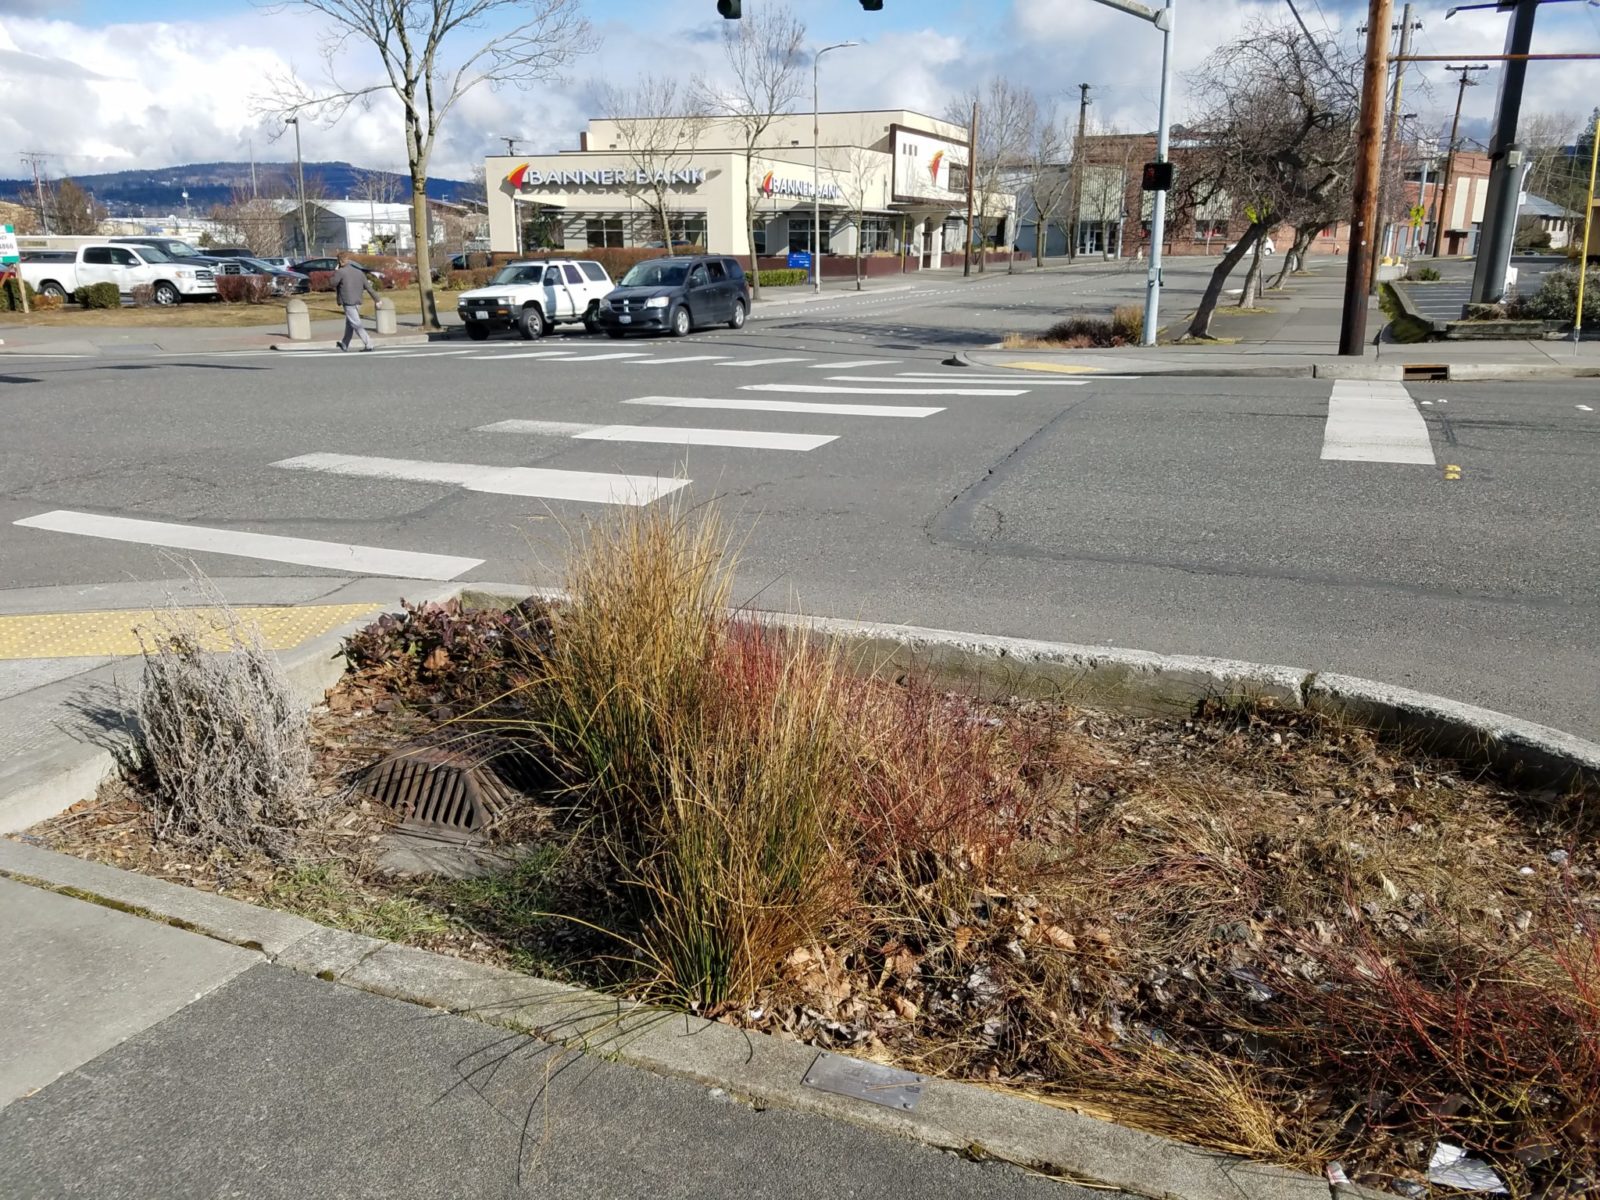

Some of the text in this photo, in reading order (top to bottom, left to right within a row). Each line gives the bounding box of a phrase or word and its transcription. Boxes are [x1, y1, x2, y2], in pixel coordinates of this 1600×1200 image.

[528, 168, 707, 185] BANNER BANK
[772, 176, 815, 197] BANNER
